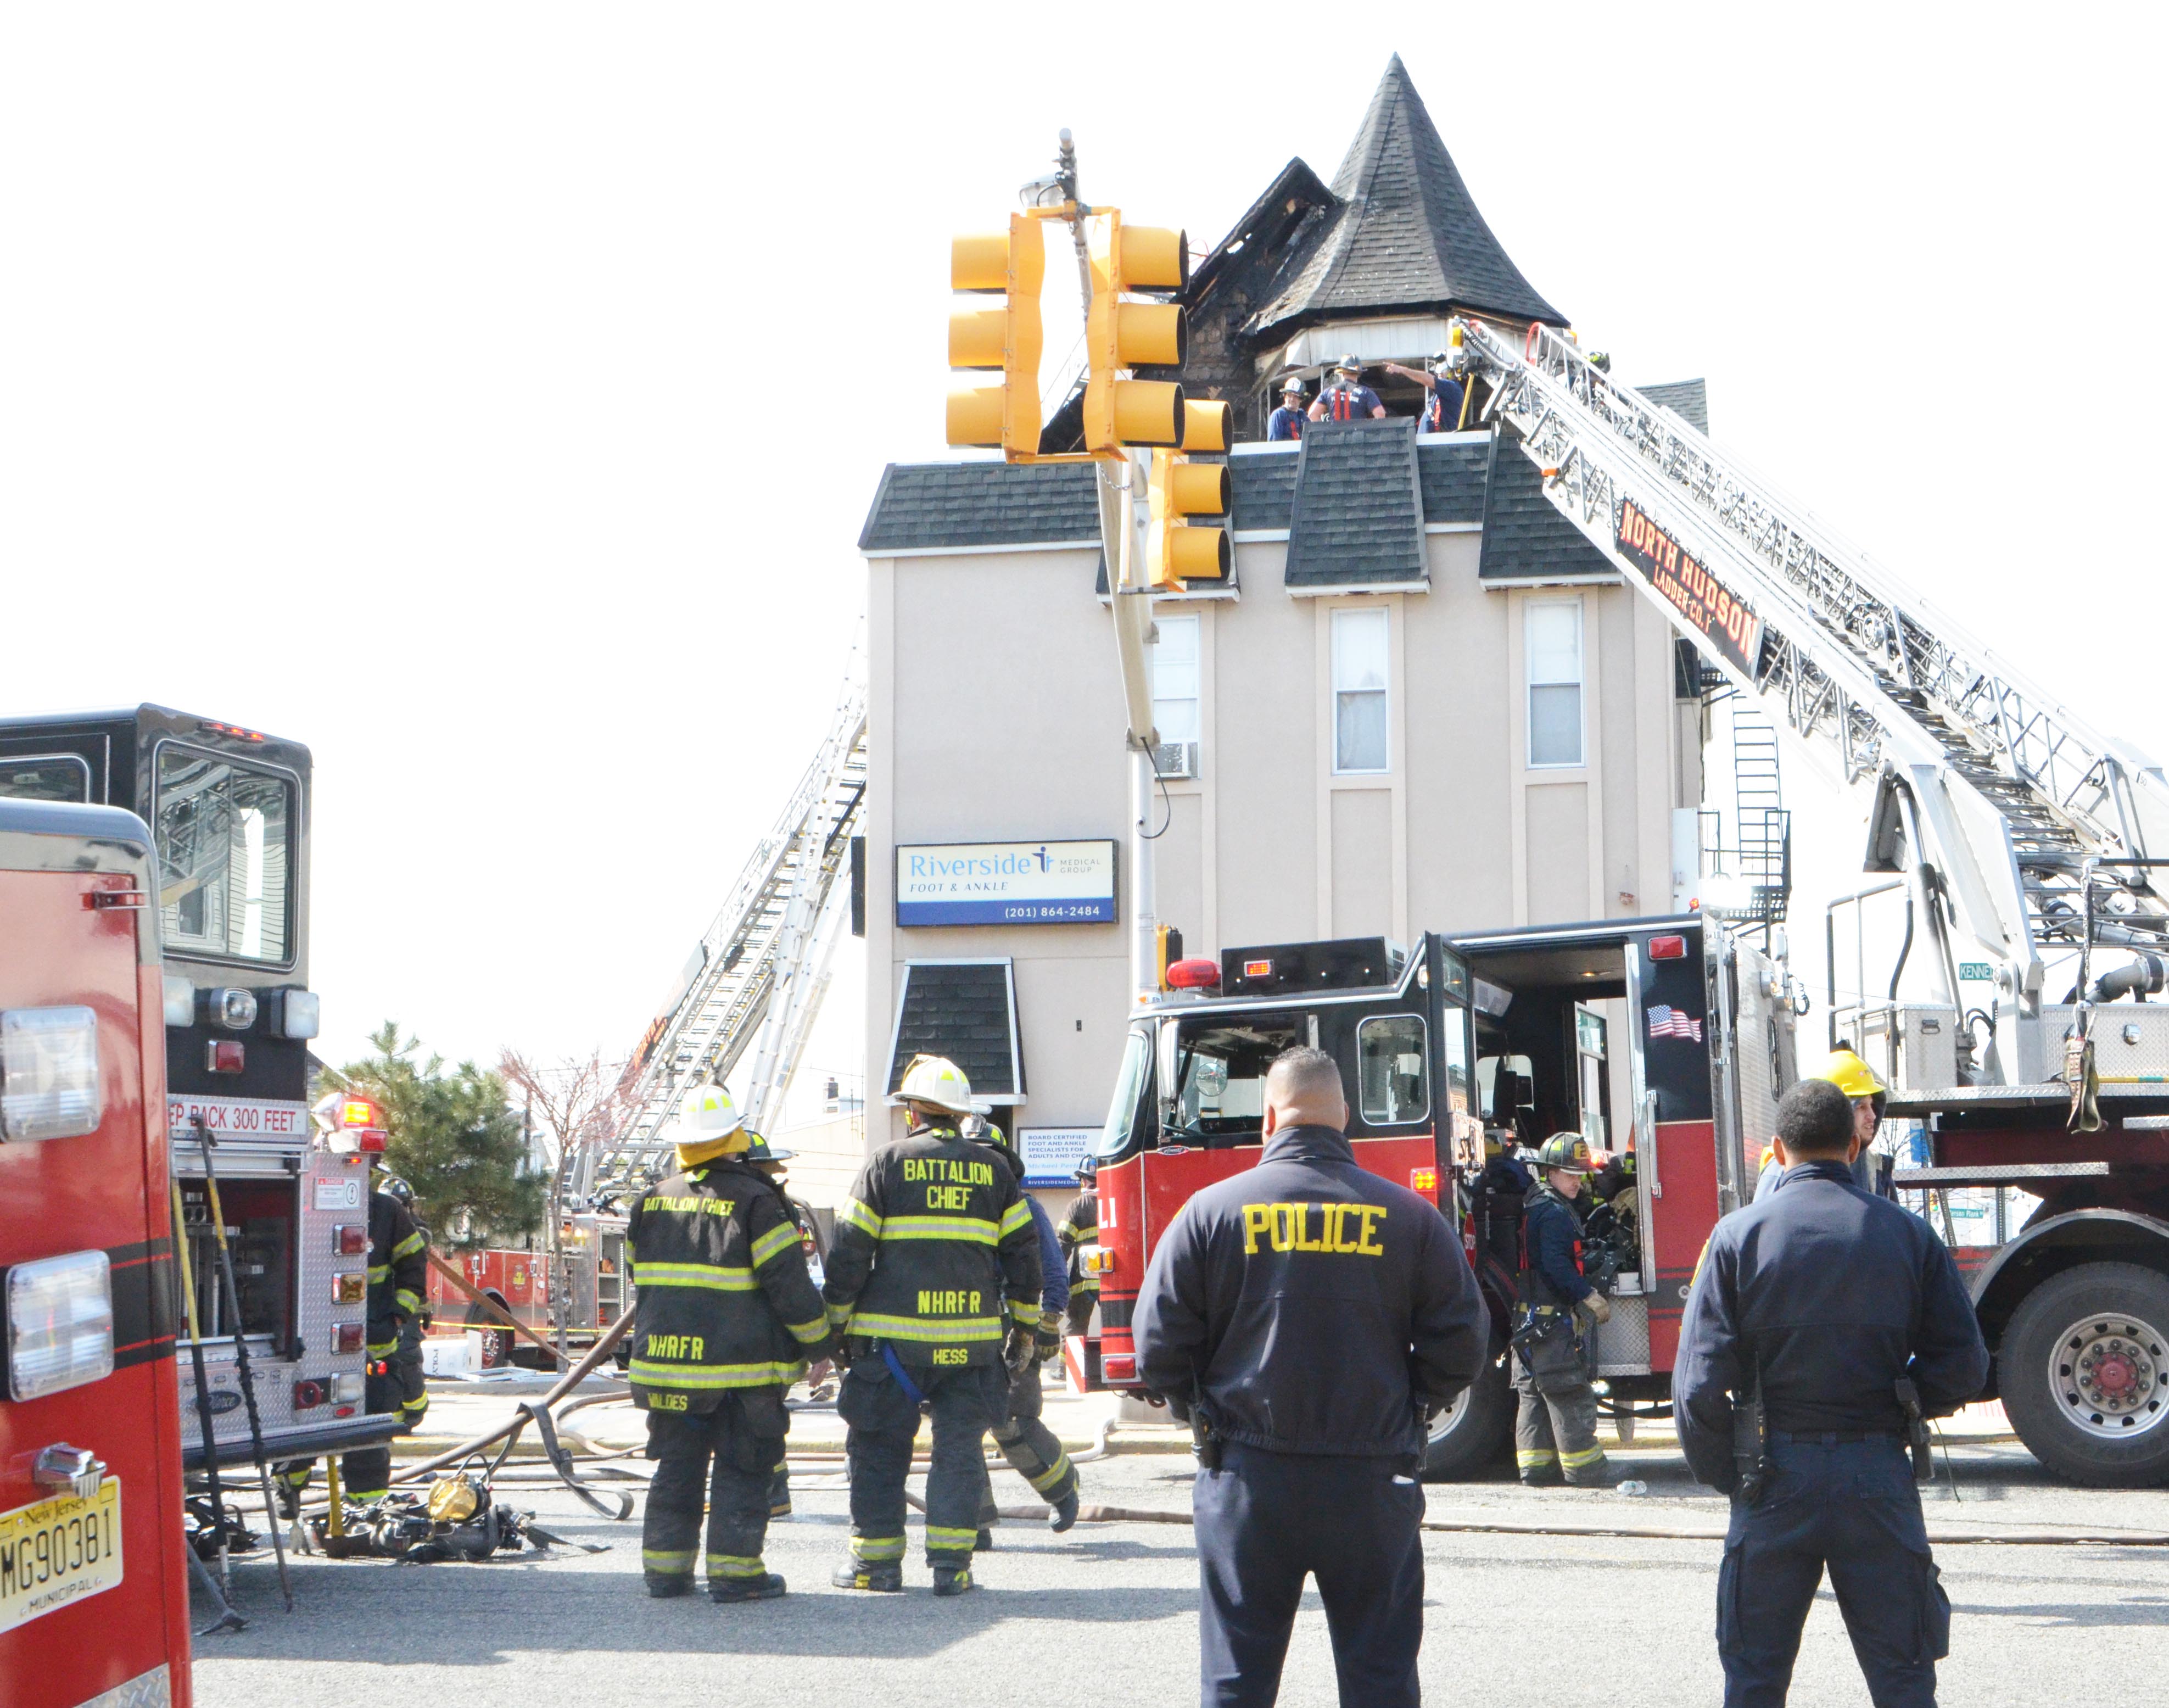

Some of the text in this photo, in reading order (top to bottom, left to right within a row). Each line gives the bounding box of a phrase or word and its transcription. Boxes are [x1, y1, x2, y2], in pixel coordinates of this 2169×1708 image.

[1621, 501, 1758, 662] NORTH HUDSON
[1653, 565, 1689, 612] LADDER
[1690, 601, 1704, 628] CO.
[910, 853, 1031, 877] Riverside
[910, 882, 1008, 892] FOOT & ANKLE
[1005, 906, 1100, 918] (201) 864-2484
[233, 1107, 259, 1130] 300
[265, 1109, 295, 1131] FEET
[904, 1159, 993, 1186] BATTALION
[642, 1197, 735, 1216] BATTALION CHIEF
[927, 1186, 972, 1210] CHIEF
[1242, 1202, 1387, 1256] POLICE
[918, 1291, 981, 1314] NHRFR
[647, 1334, 705, 1360] NHRFR
[933, 1348, 968, 1365] HESS
[24, 1498, 87, 1527] New Jersey
[1, 1508, 111, 1599] MG90381
[29, 1578, 93, 1613] MUNICIPAL
